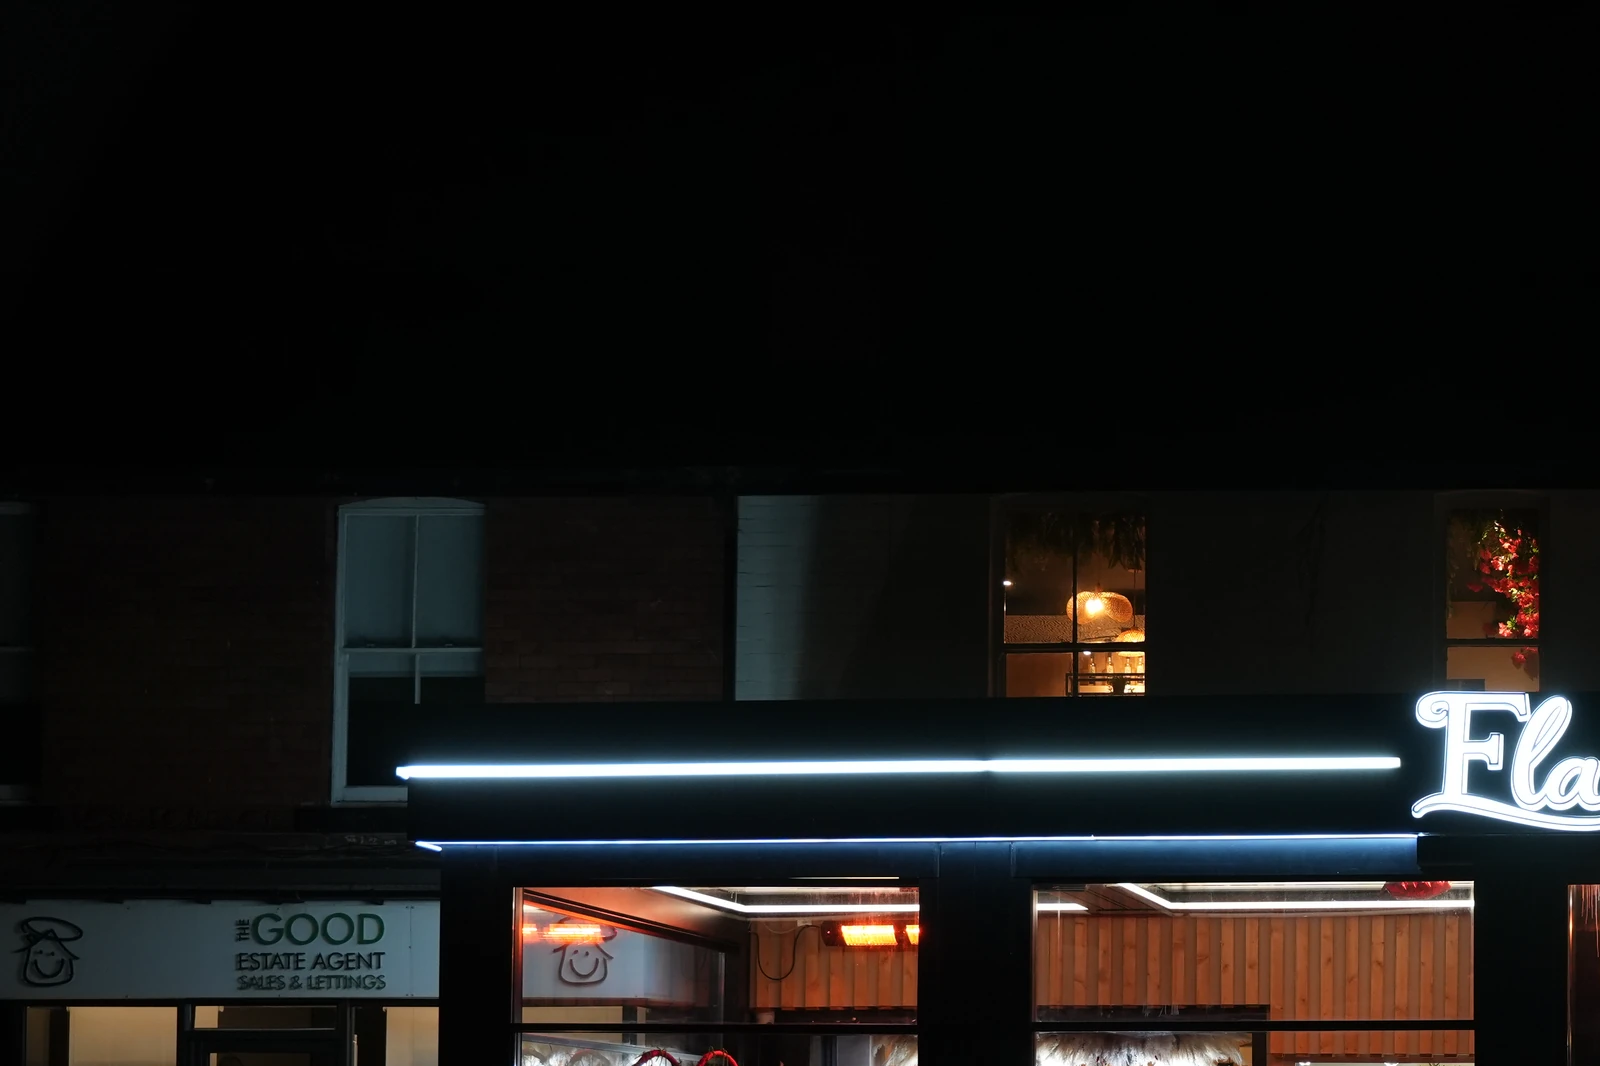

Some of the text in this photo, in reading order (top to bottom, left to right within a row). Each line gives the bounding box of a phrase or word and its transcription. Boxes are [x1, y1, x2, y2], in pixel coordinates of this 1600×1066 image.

[236, 912, 385, 946] THE GOOD
[236, 951, 386, 970] ESTATE AGENT
[237, 974, 387, 991] SALES & LETTINGS
